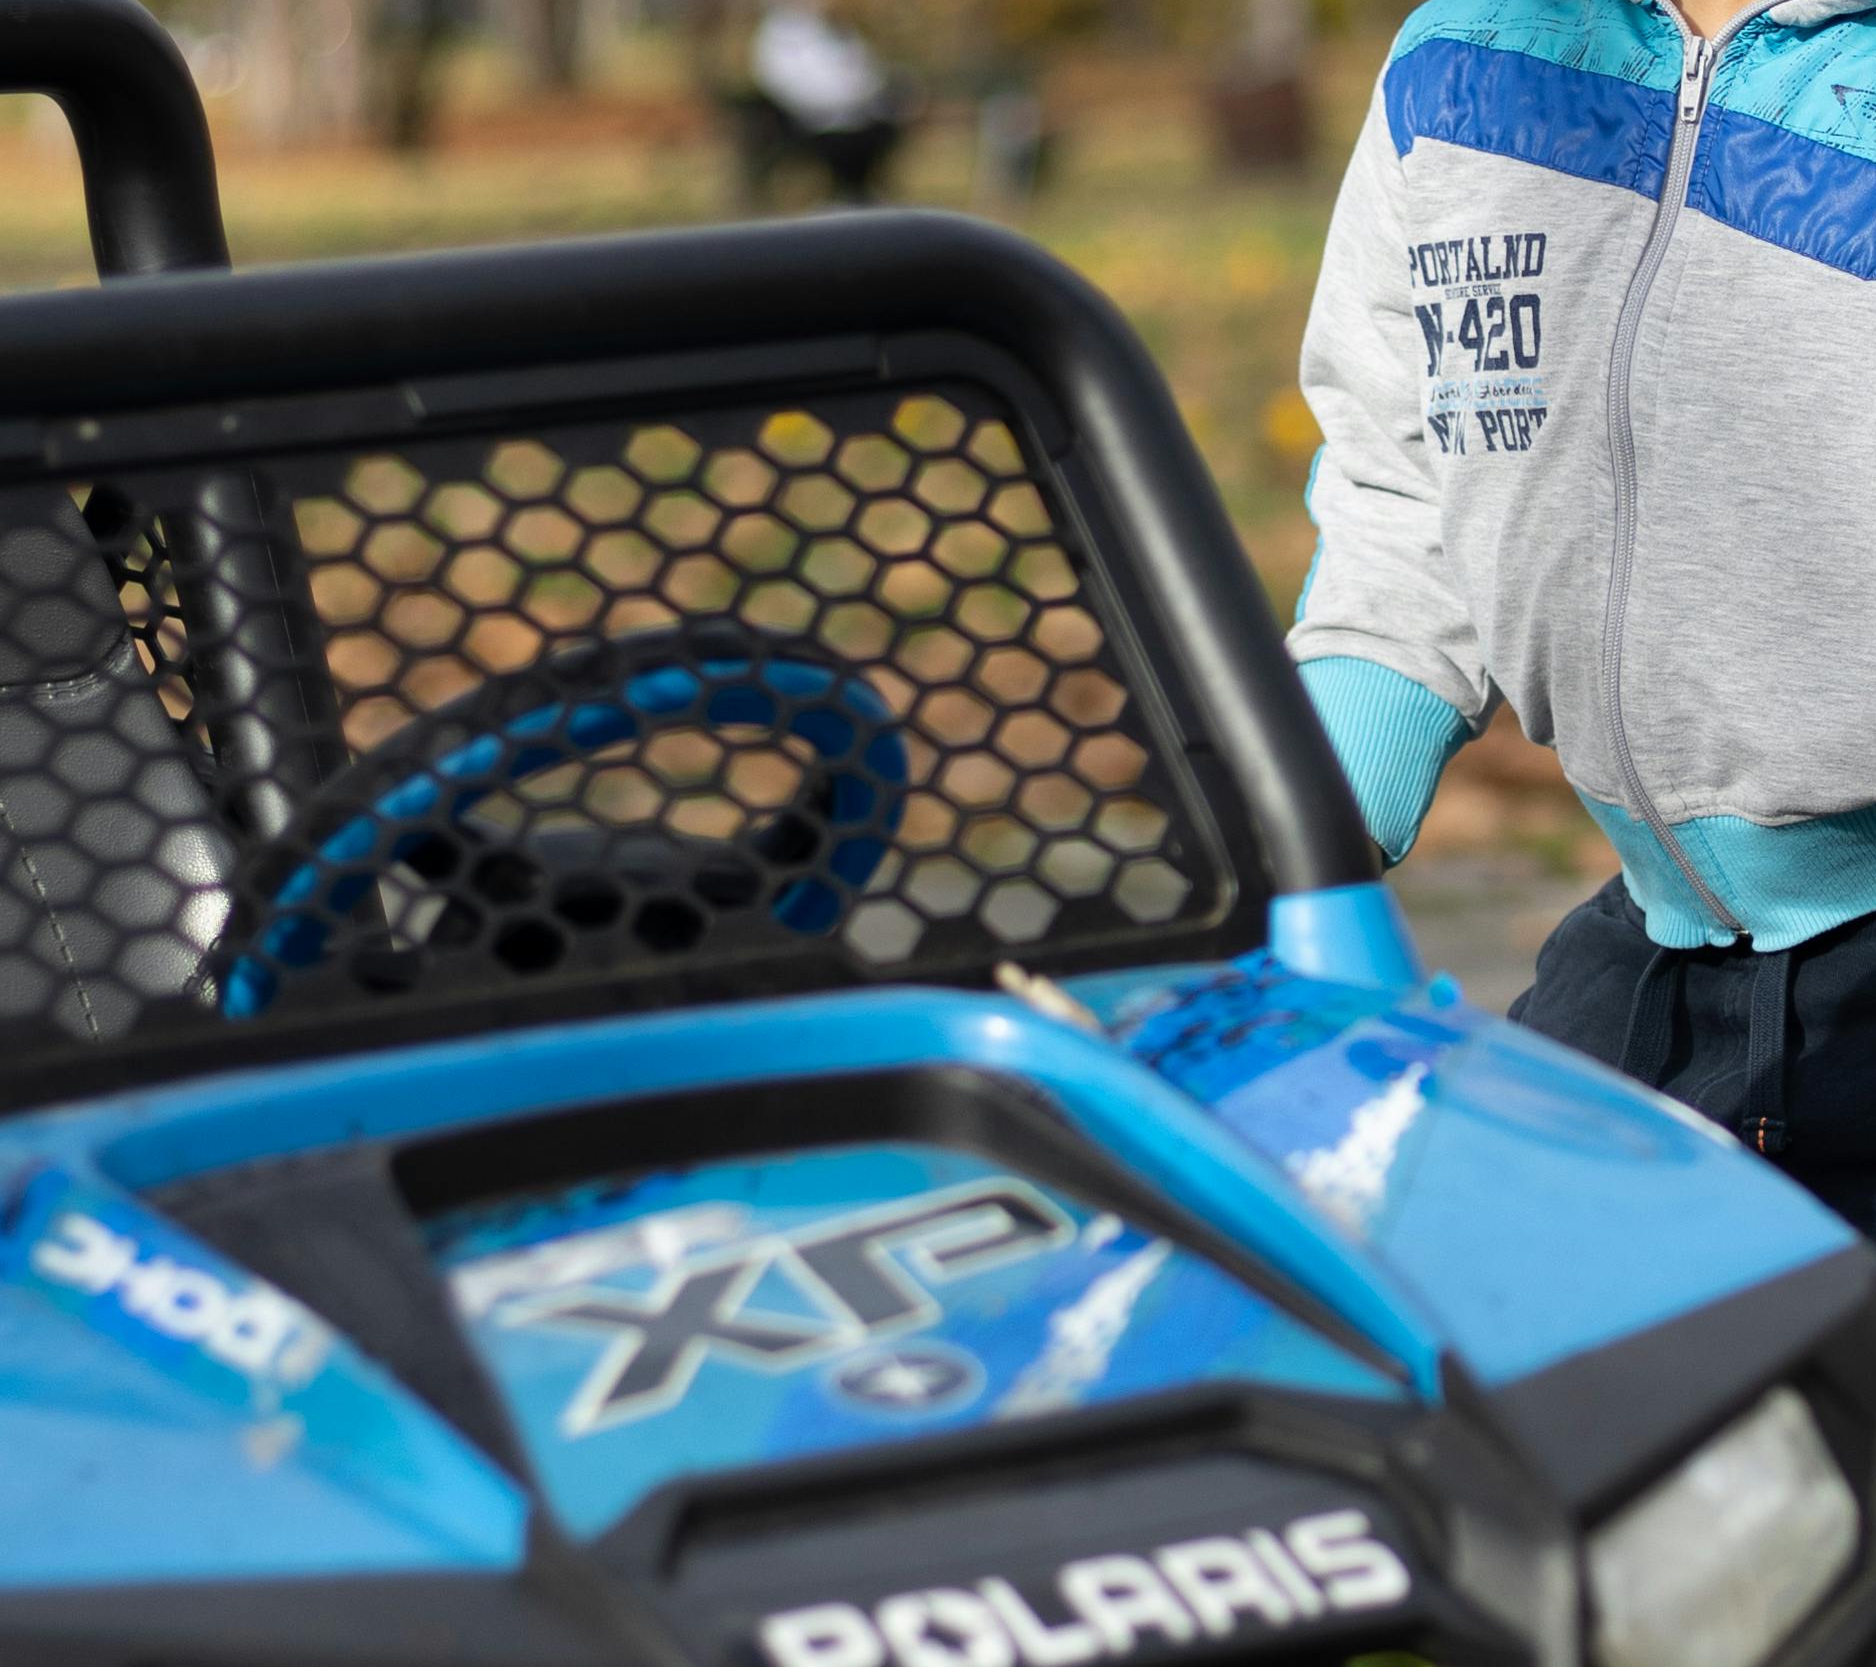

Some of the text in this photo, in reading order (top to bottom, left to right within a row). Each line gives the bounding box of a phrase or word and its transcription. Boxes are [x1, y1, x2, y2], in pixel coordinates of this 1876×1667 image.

[1408, 232, 1547, 289] PORTALND
[1427, 407, 1547, 455] NW PORT
[498, 1176, 1080, 1439] XP
